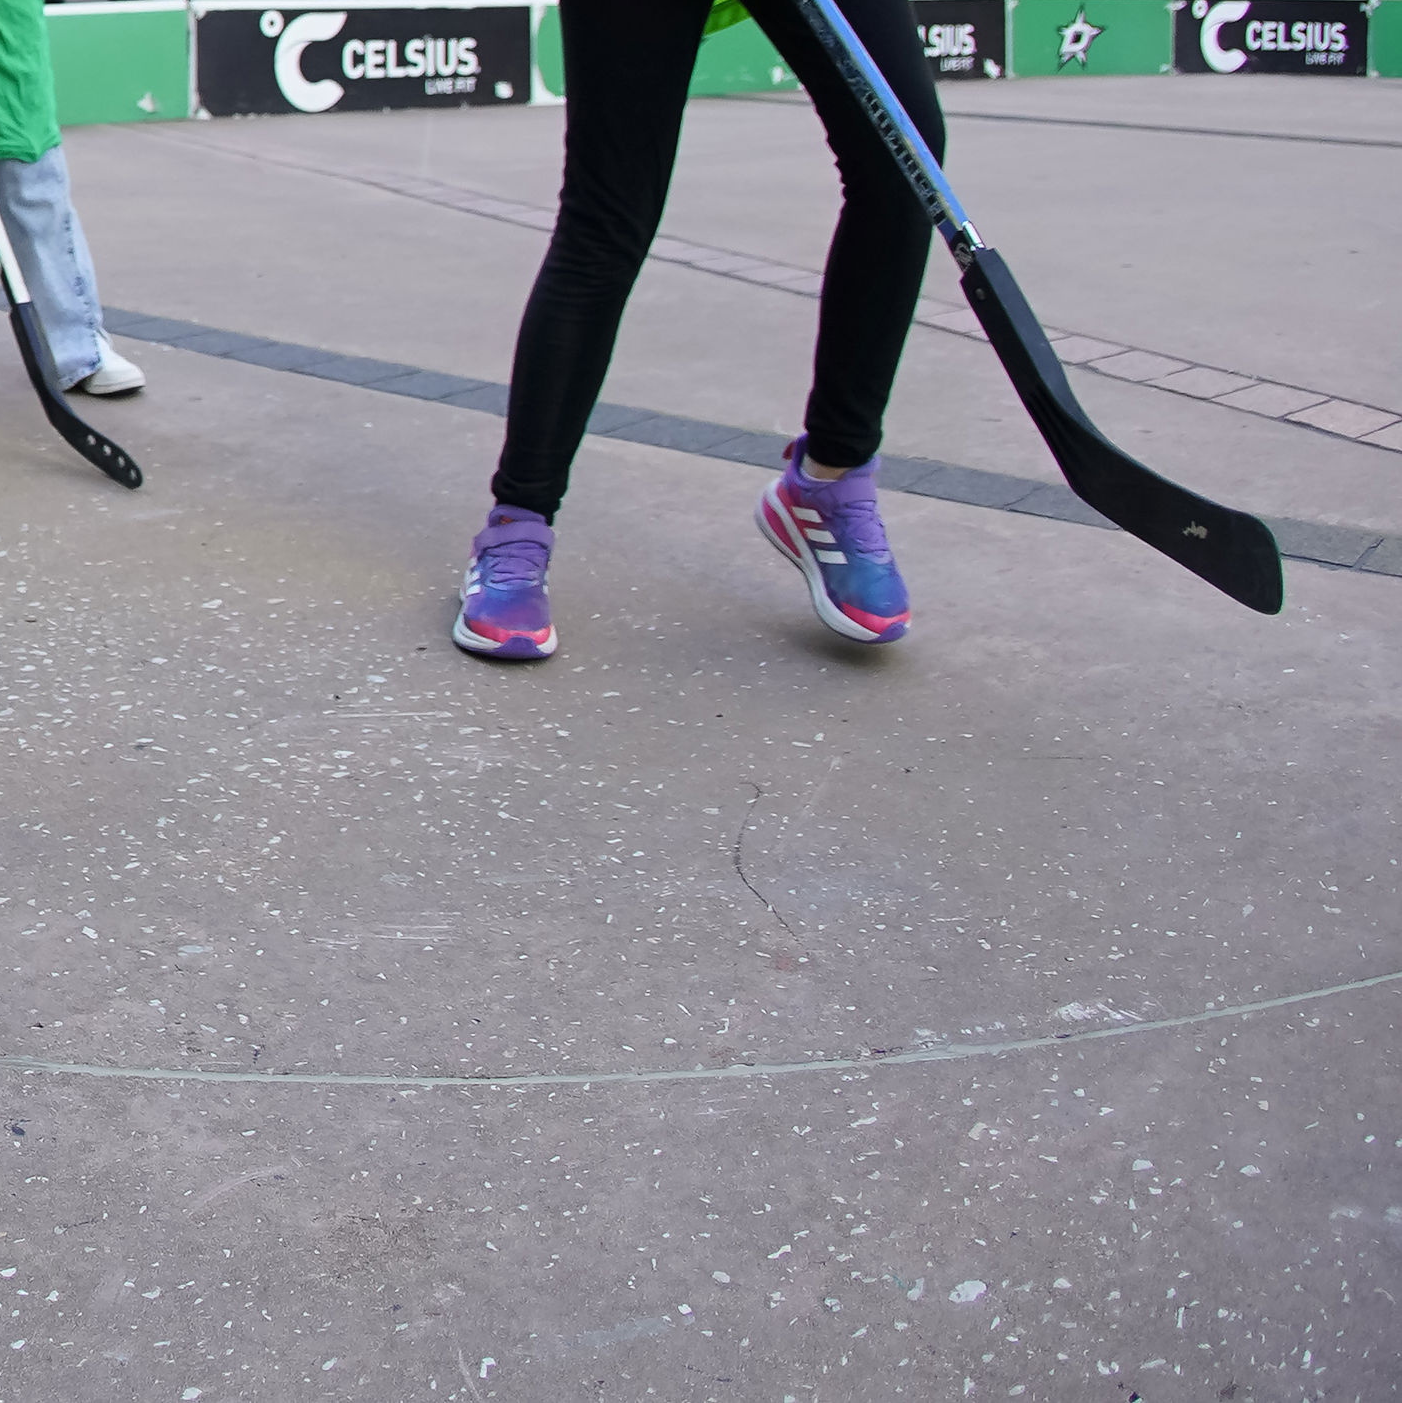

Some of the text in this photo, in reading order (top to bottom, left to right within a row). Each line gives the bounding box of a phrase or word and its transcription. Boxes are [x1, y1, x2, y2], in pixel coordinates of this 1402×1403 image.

[917, 22, 976, 57] LSIUS
[1245, 21, 1349, 52] CELSIUS
[342, 38, 479, 79] CELSIUS
